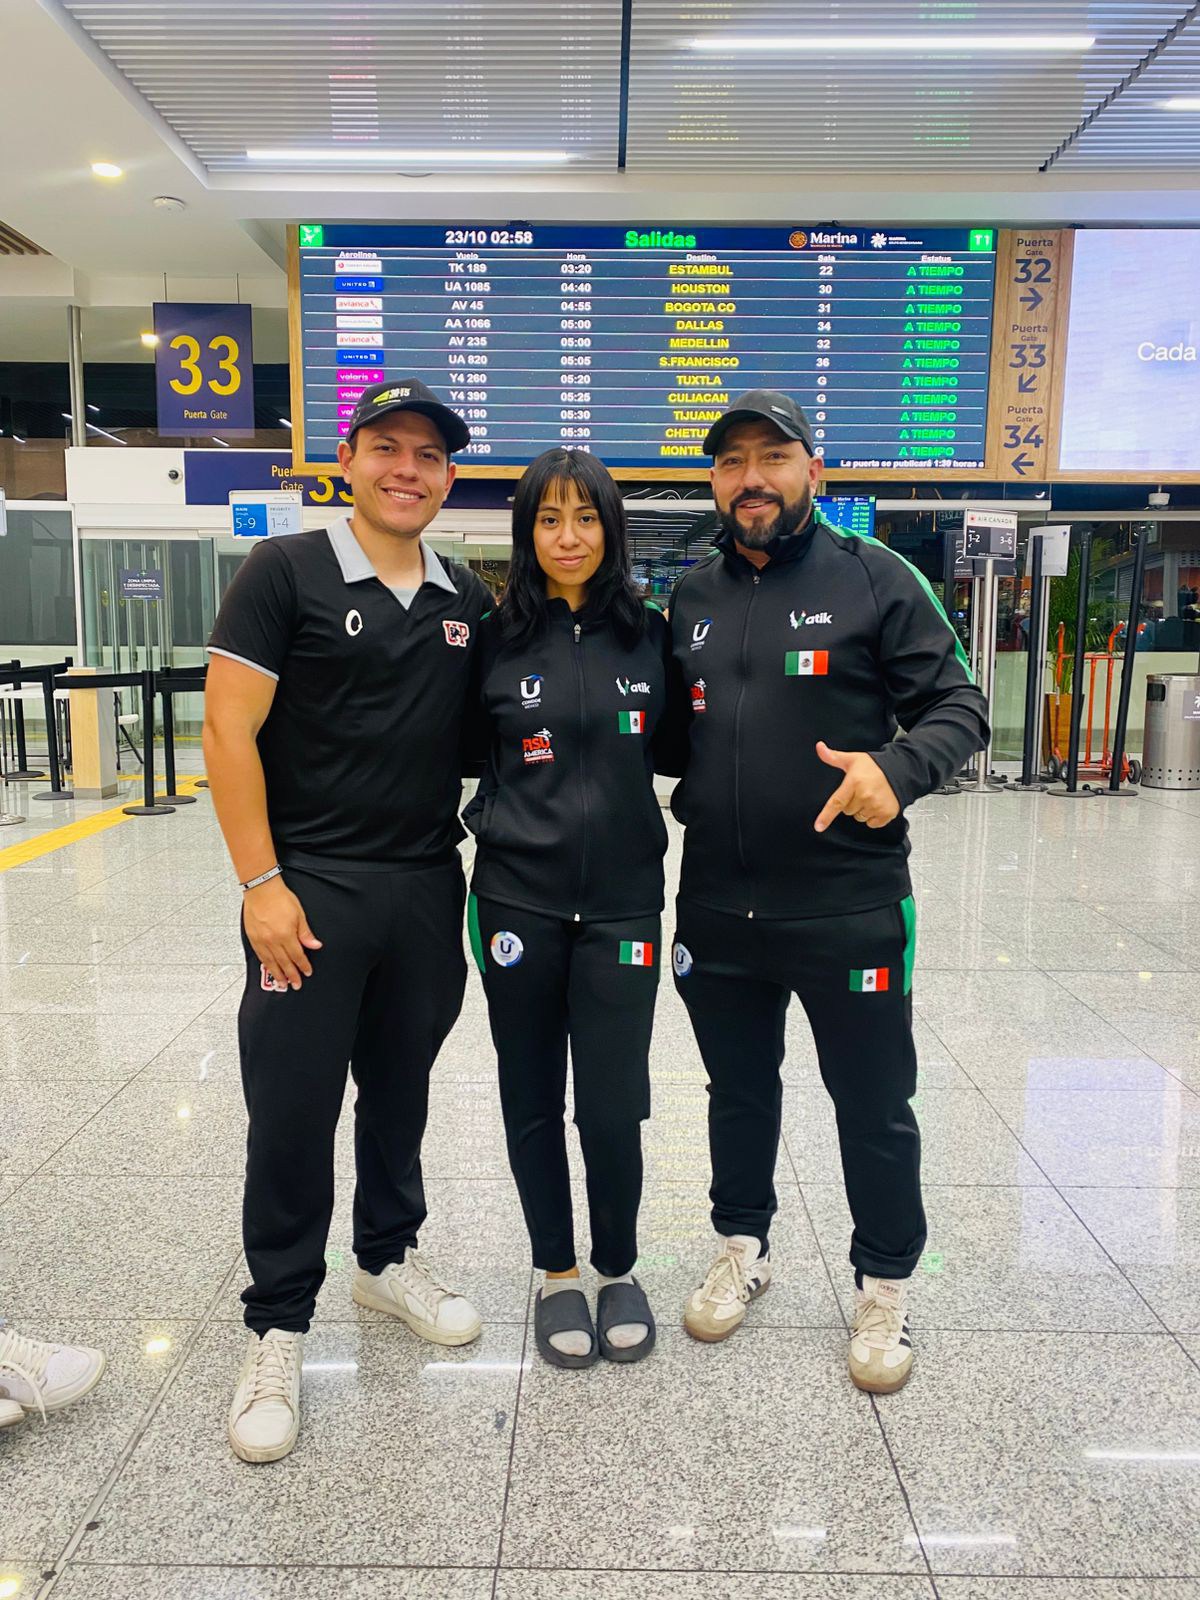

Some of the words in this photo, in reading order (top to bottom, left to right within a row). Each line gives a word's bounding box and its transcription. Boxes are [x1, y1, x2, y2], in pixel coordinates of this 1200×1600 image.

[445, 230, 486, 245] 23/10
[490, 231, 533, 245] 02:58
[625, 230, 696, 249] Salidas
[810, 232, 858, 244] Marina
[1016, 238, 1054, 248] Puerta
[456, 252, 479, 260] Vuelo
[566, 252, 586, 260] Hora
[686, 253, 717, 262] Destino
[920, 255, 952, 263] Estatus
[449, 262, 464, 273] TK
[467, 263, 486, 273] 189
[561, 263, 591, 274] 03:20
[670, 264, 732, 276] ESTAMBUL
[820, 265, 832, 276] 22
[907, 265, 916, 277] A
[919, 265, 964, 278] TIEMPO
[1014, 258, 1052, 284] 32
[445, 281, 462, 292] UA
[465, 281, 490, 292] 1085
[561, 282, 591, 293] 04:40
[672, 283, 729, 294] HOUSTON
[819, 284, 832, 294] 30
[906, 284, 915, 296] A
[919, 284, 963, 297] TIEMPO
[338, 300, 370, 308] avianca
[452, 300, 467, 311] AV
[470, 300, 483, 311] 45
[561, 301, 591, 312] 04:55
[665, 302, 716, 313] BOGOTA
[717, 302, 735, 313] CO
[818, 303, 830, 313] 31
[906, 303, 914, 315] A
[917, 303, 961, 316] TIEMPO
[445, 318, 462, 329] AA
[465, 318, 490, 329] 1066
[561, 319, 591, 330] 05:00
[677, 320, 723, 331] DALLAS
[818, 321, 831, 331] 34
[904, 321, 913, 333] A
[916, 321, 961, 334] TIEMPO
[1012, 324, 1048, 334] Puerta
[449, 336, 464, 346] AV
[467, 336, 487, 347] 235
[561, 337, 591, 348] 05:00
[670, 337, 729, 349] MEDELLIN
[817, 339, 830, 349] 32
[904, 339, 912, 350] A
[915, 339, 960, 352] TIEMPO
[1009, 344, 1046, 368] 33
[1136, 342, 1197, 362] Cada
[168, 334, 241, 396] 33
[449, 354, 465, 365] UA
[468, 354, 487, 365] 820
[561, 355, 591, 366] 05:05
[660, 356, 739, 368] S.FRANCISCO
[816, 357, 829, 368] 36
[903, 357, 912, 369] A
[914, 357, 959, 370] TIEMPO
[339, 373, 368, 381] volaris
[450, 372, 464, 384] Y4
[467, 373, 487, 384] 260
[561, 374, 590, 385] 05:20
[677, 375, 721, 386] TUXTLA
[816, 376, 827, 386] G
[903, 376, 912, 387] A
[913, 375, 958, 388] TIEMPO
[450, 390, 465, 401] Y4
[467, 391, 487, 402] 390
[561, 391, 590, 403] 05:25
[668, 392, 728, 404] CULIACAN
[816, 393, 827, 404] G
[902, 393, 910, 405] A
[913, 393, 957, 406] TIEMPO
[183, 409, 207, 420] Puerta
[210, 409, 228, 420] Gate
[468, 408, 487, 419] 190
[561, 409, 590, 420] 05:30
[1007, 405, 1044, 414] Puerta
[816, 411, 826, 422] G
[900, 411, 910, 422] A
[912, 410, 956, 423] TIEMPO
[561, 427, 590, 438] 05:30
[816, 428, 825, 439] G
[900, 429, 910, 440] A
[912, 428, 955, 441] TIEMPO
[1003, 424, 1044, 448] 34
[466, 443, 491, 454] 1120
[661, 445, 702, 457] MONTE
[899, 447, 908, 457] A
[911, 445, 954, 458] TIEMPO
[271, 464, 293, 477] Puer
[280, 480, 304, 491] Gate
[235, 517, 256, 529] 5-9
[272, 517, 289, 528] 1-4
[968, 534, 980, 543] 1-2
[1000, 536, 1013, 544] 3-6
